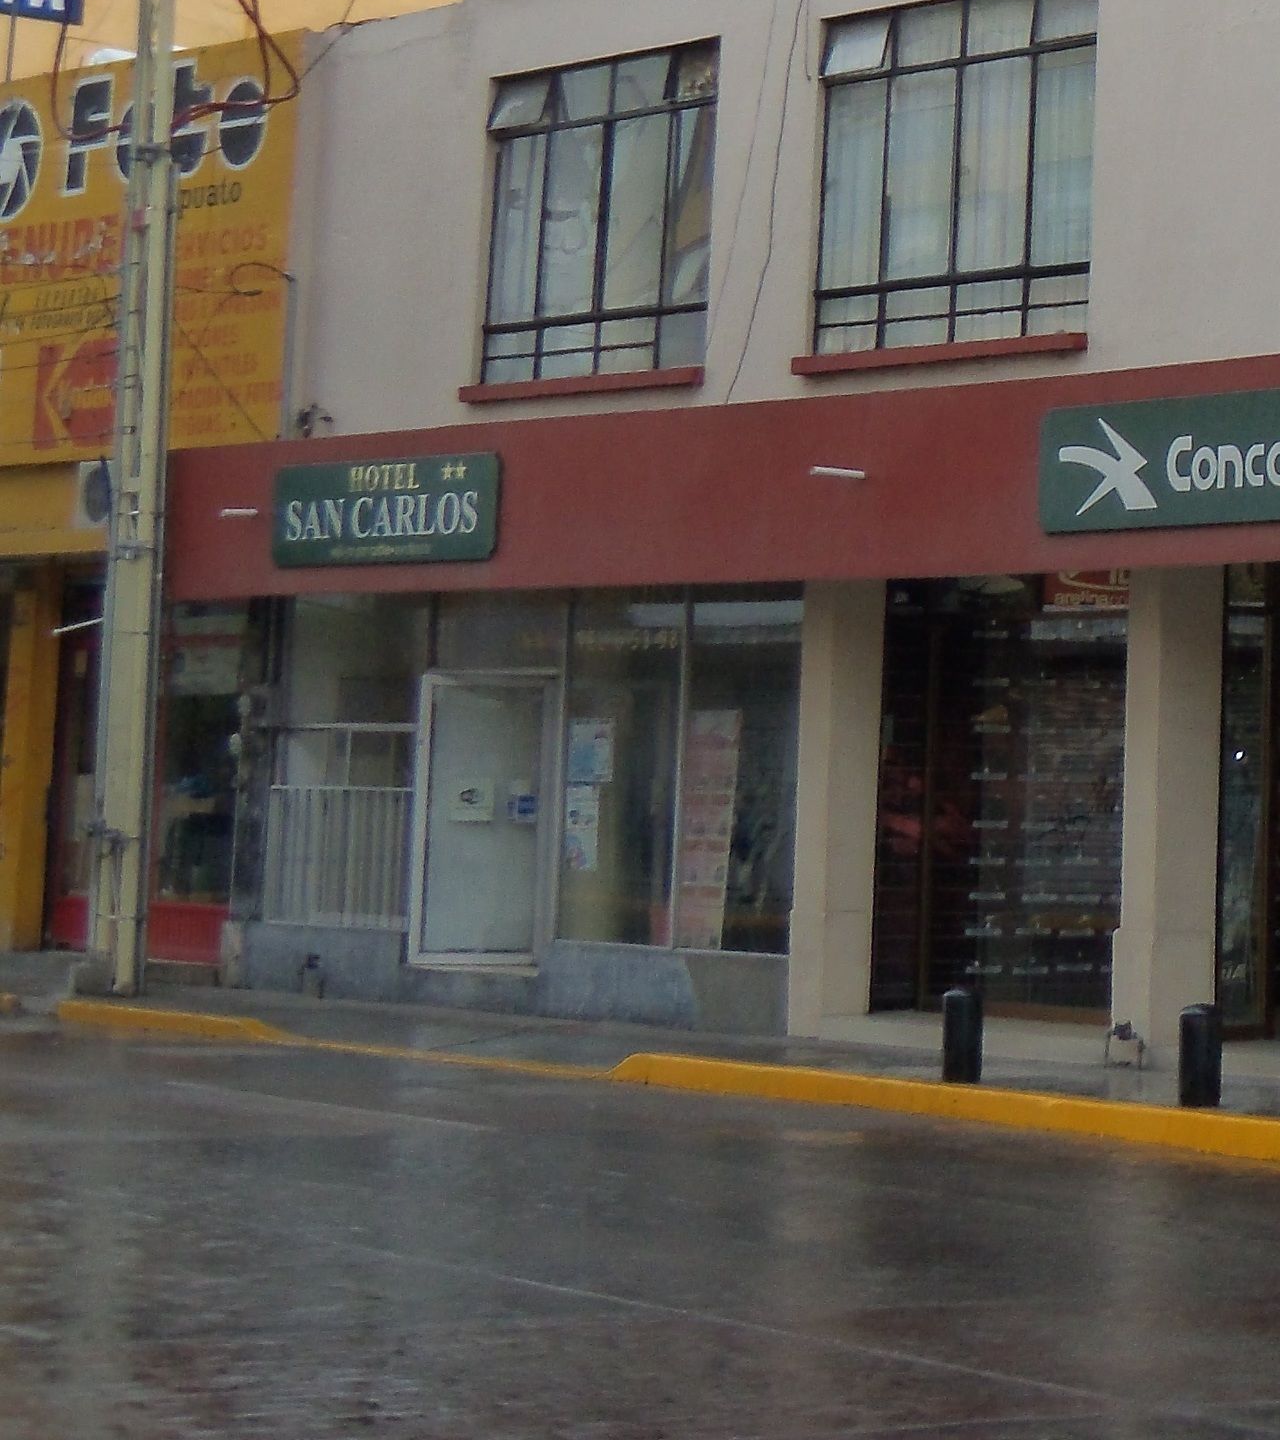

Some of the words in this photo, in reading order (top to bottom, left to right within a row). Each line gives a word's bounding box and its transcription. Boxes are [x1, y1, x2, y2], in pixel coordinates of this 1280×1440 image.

[350, 463, 420, 492] HOTEL
[286, 498, 345, 541] SAN
[352, 490, 478, 539] CARLOS
